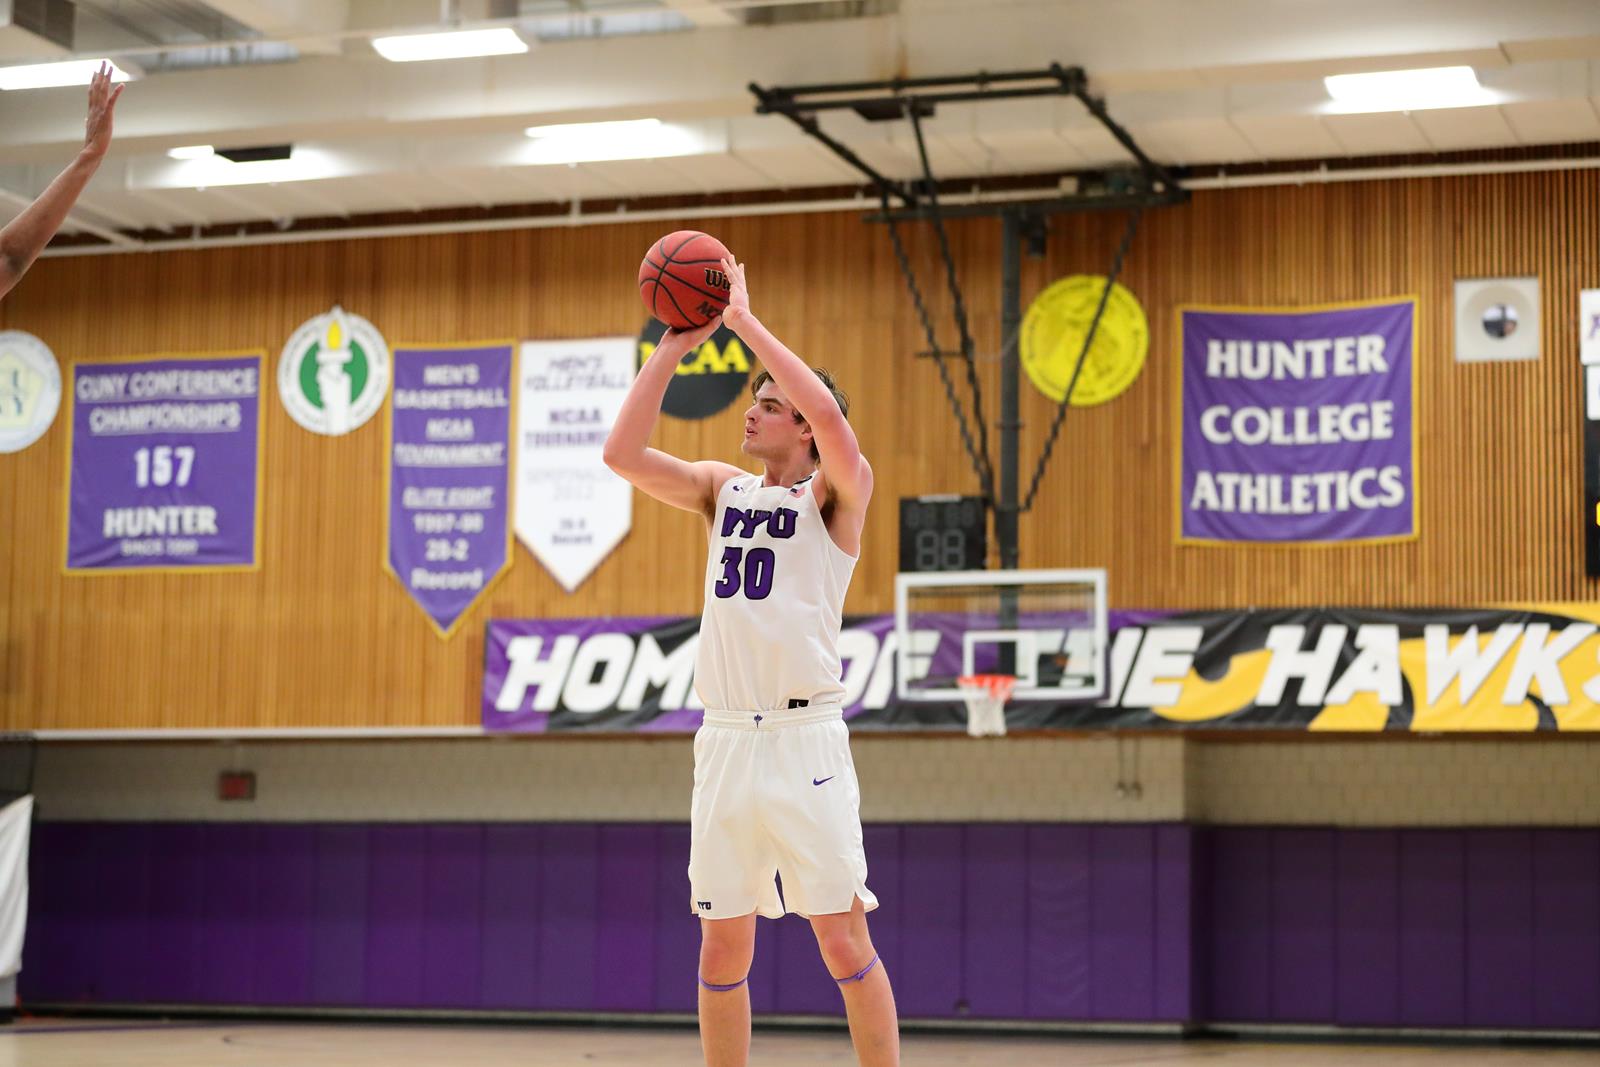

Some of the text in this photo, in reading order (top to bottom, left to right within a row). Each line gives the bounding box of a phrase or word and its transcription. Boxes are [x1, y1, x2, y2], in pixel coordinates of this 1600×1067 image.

[547, 354, 605, 373] MEN'S
[1206, 334, 1389, 380] HUNTER
[77, 367, 256, 400] CUNY CONFERENCE
[423, 364, 480, 386] MEN'S
[525, 372, 628, 392] VOLLEYBALL
[395, 387, 508, 410] BASKETBALL
[89, 402, 241, 433] CHAMPIONSHIPS
[425, 418, 475, 441] NCAA
[549, 407, 603, 426] NCAA
[1201, 401, 1394, 445] COLLEGE
[134, 446, 195, 488] 157
[394, 441, 505, 467] TOURNAMENT
[1190, 465, 1405, 514] ATHLETICS
[103, 506, 218, 538] HUNTER
[721, 506, 798, 539] NYU
[410, 567, 484, 590] Record
[715, 547, 775, 600] 30
[496, 632, 704, 712] HOM
